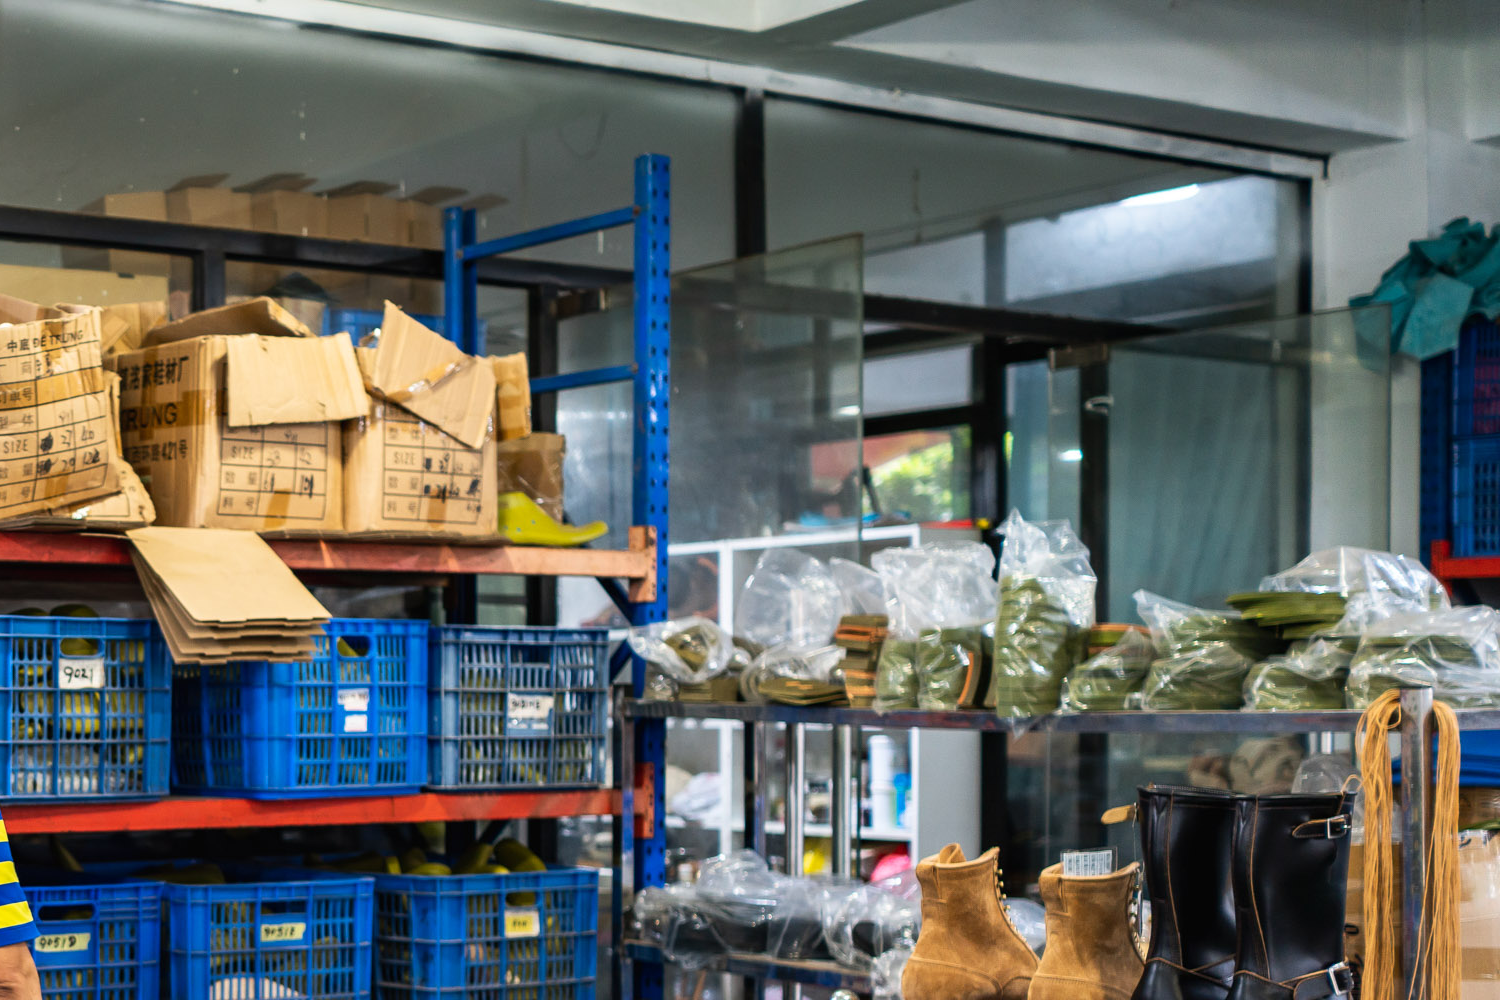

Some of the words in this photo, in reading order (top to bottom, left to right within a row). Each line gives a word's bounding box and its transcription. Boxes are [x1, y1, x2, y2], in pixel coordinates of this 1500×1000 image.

[7, 338, 31, 352] 中底
[3, 438, 29, 454] SIZE
[231, 446, 255, 460] SIZE
[63, 665, 94, 685] 9021
